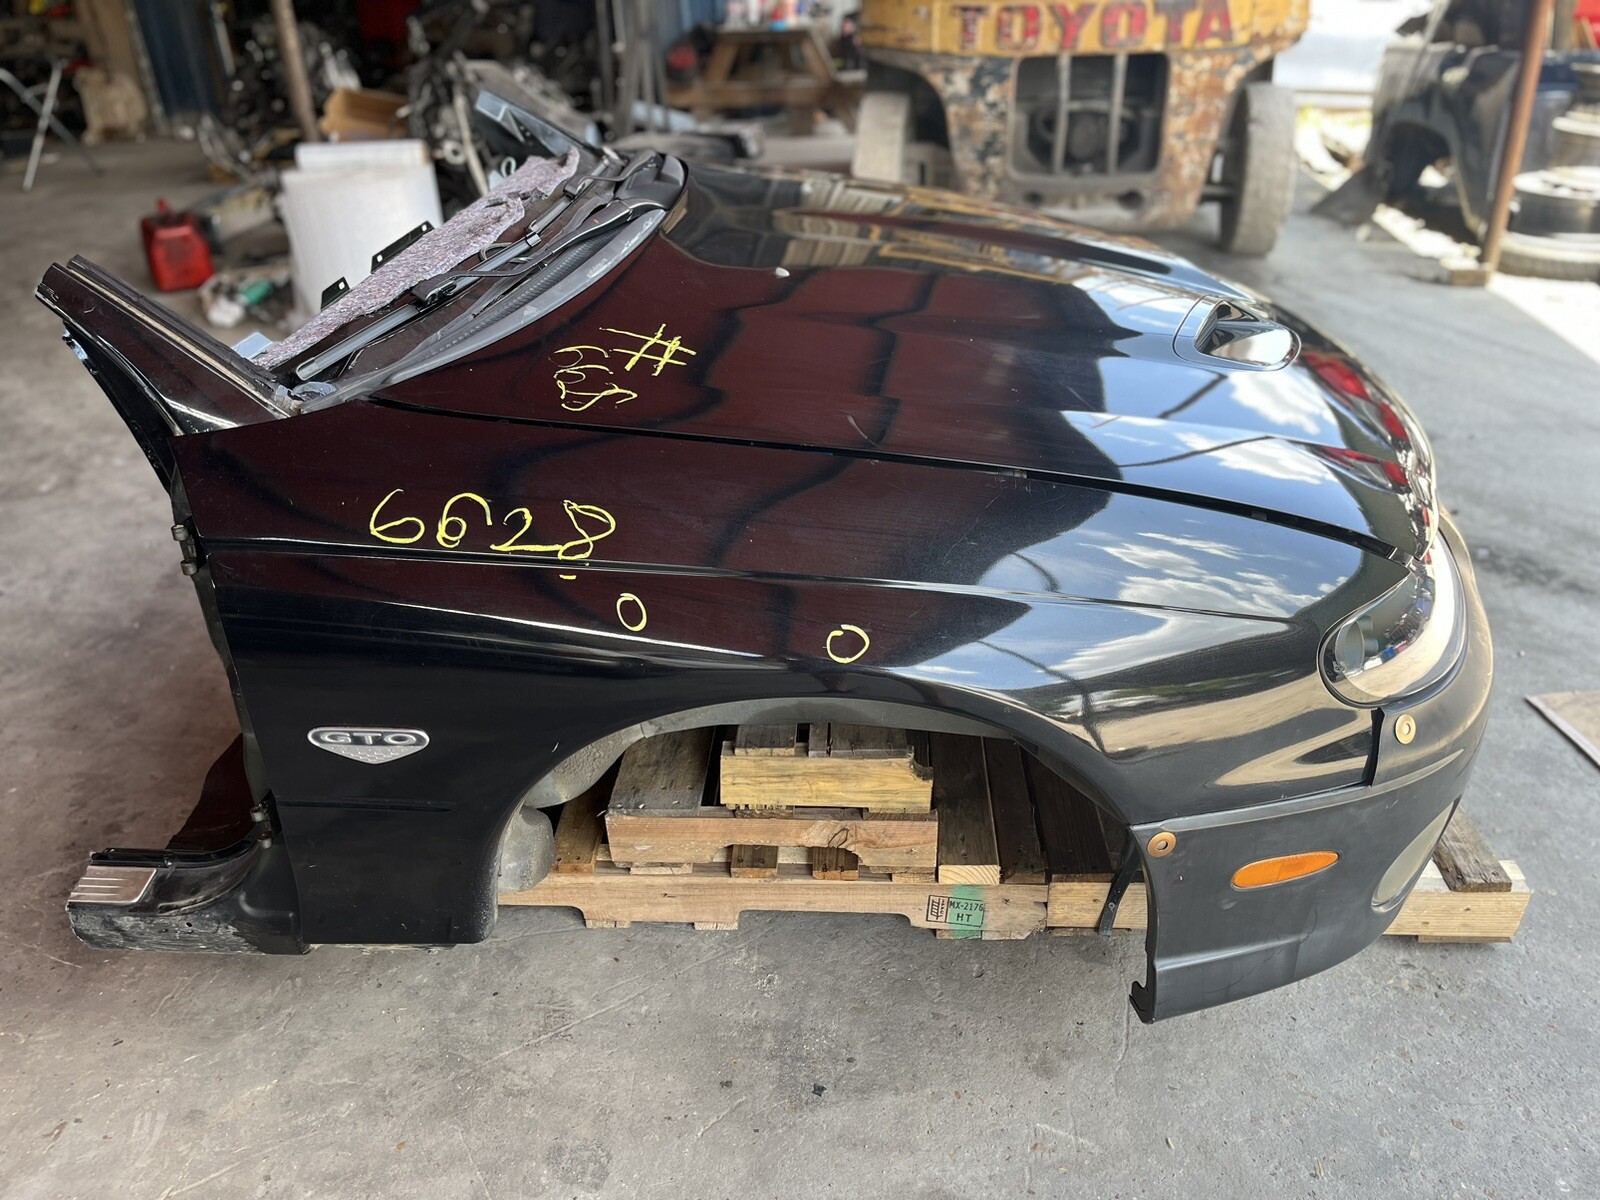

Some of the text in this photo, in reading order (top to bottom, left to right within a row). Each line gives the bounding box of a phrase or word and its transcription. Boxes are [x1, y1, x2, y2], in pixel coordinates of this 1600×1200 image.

[951, 0, 1233, 50] TOYOTA
[369, 488, 616, 560] 6628
[319, 731, 417, 745] GTO
[956, 912, 973, 923] HT
